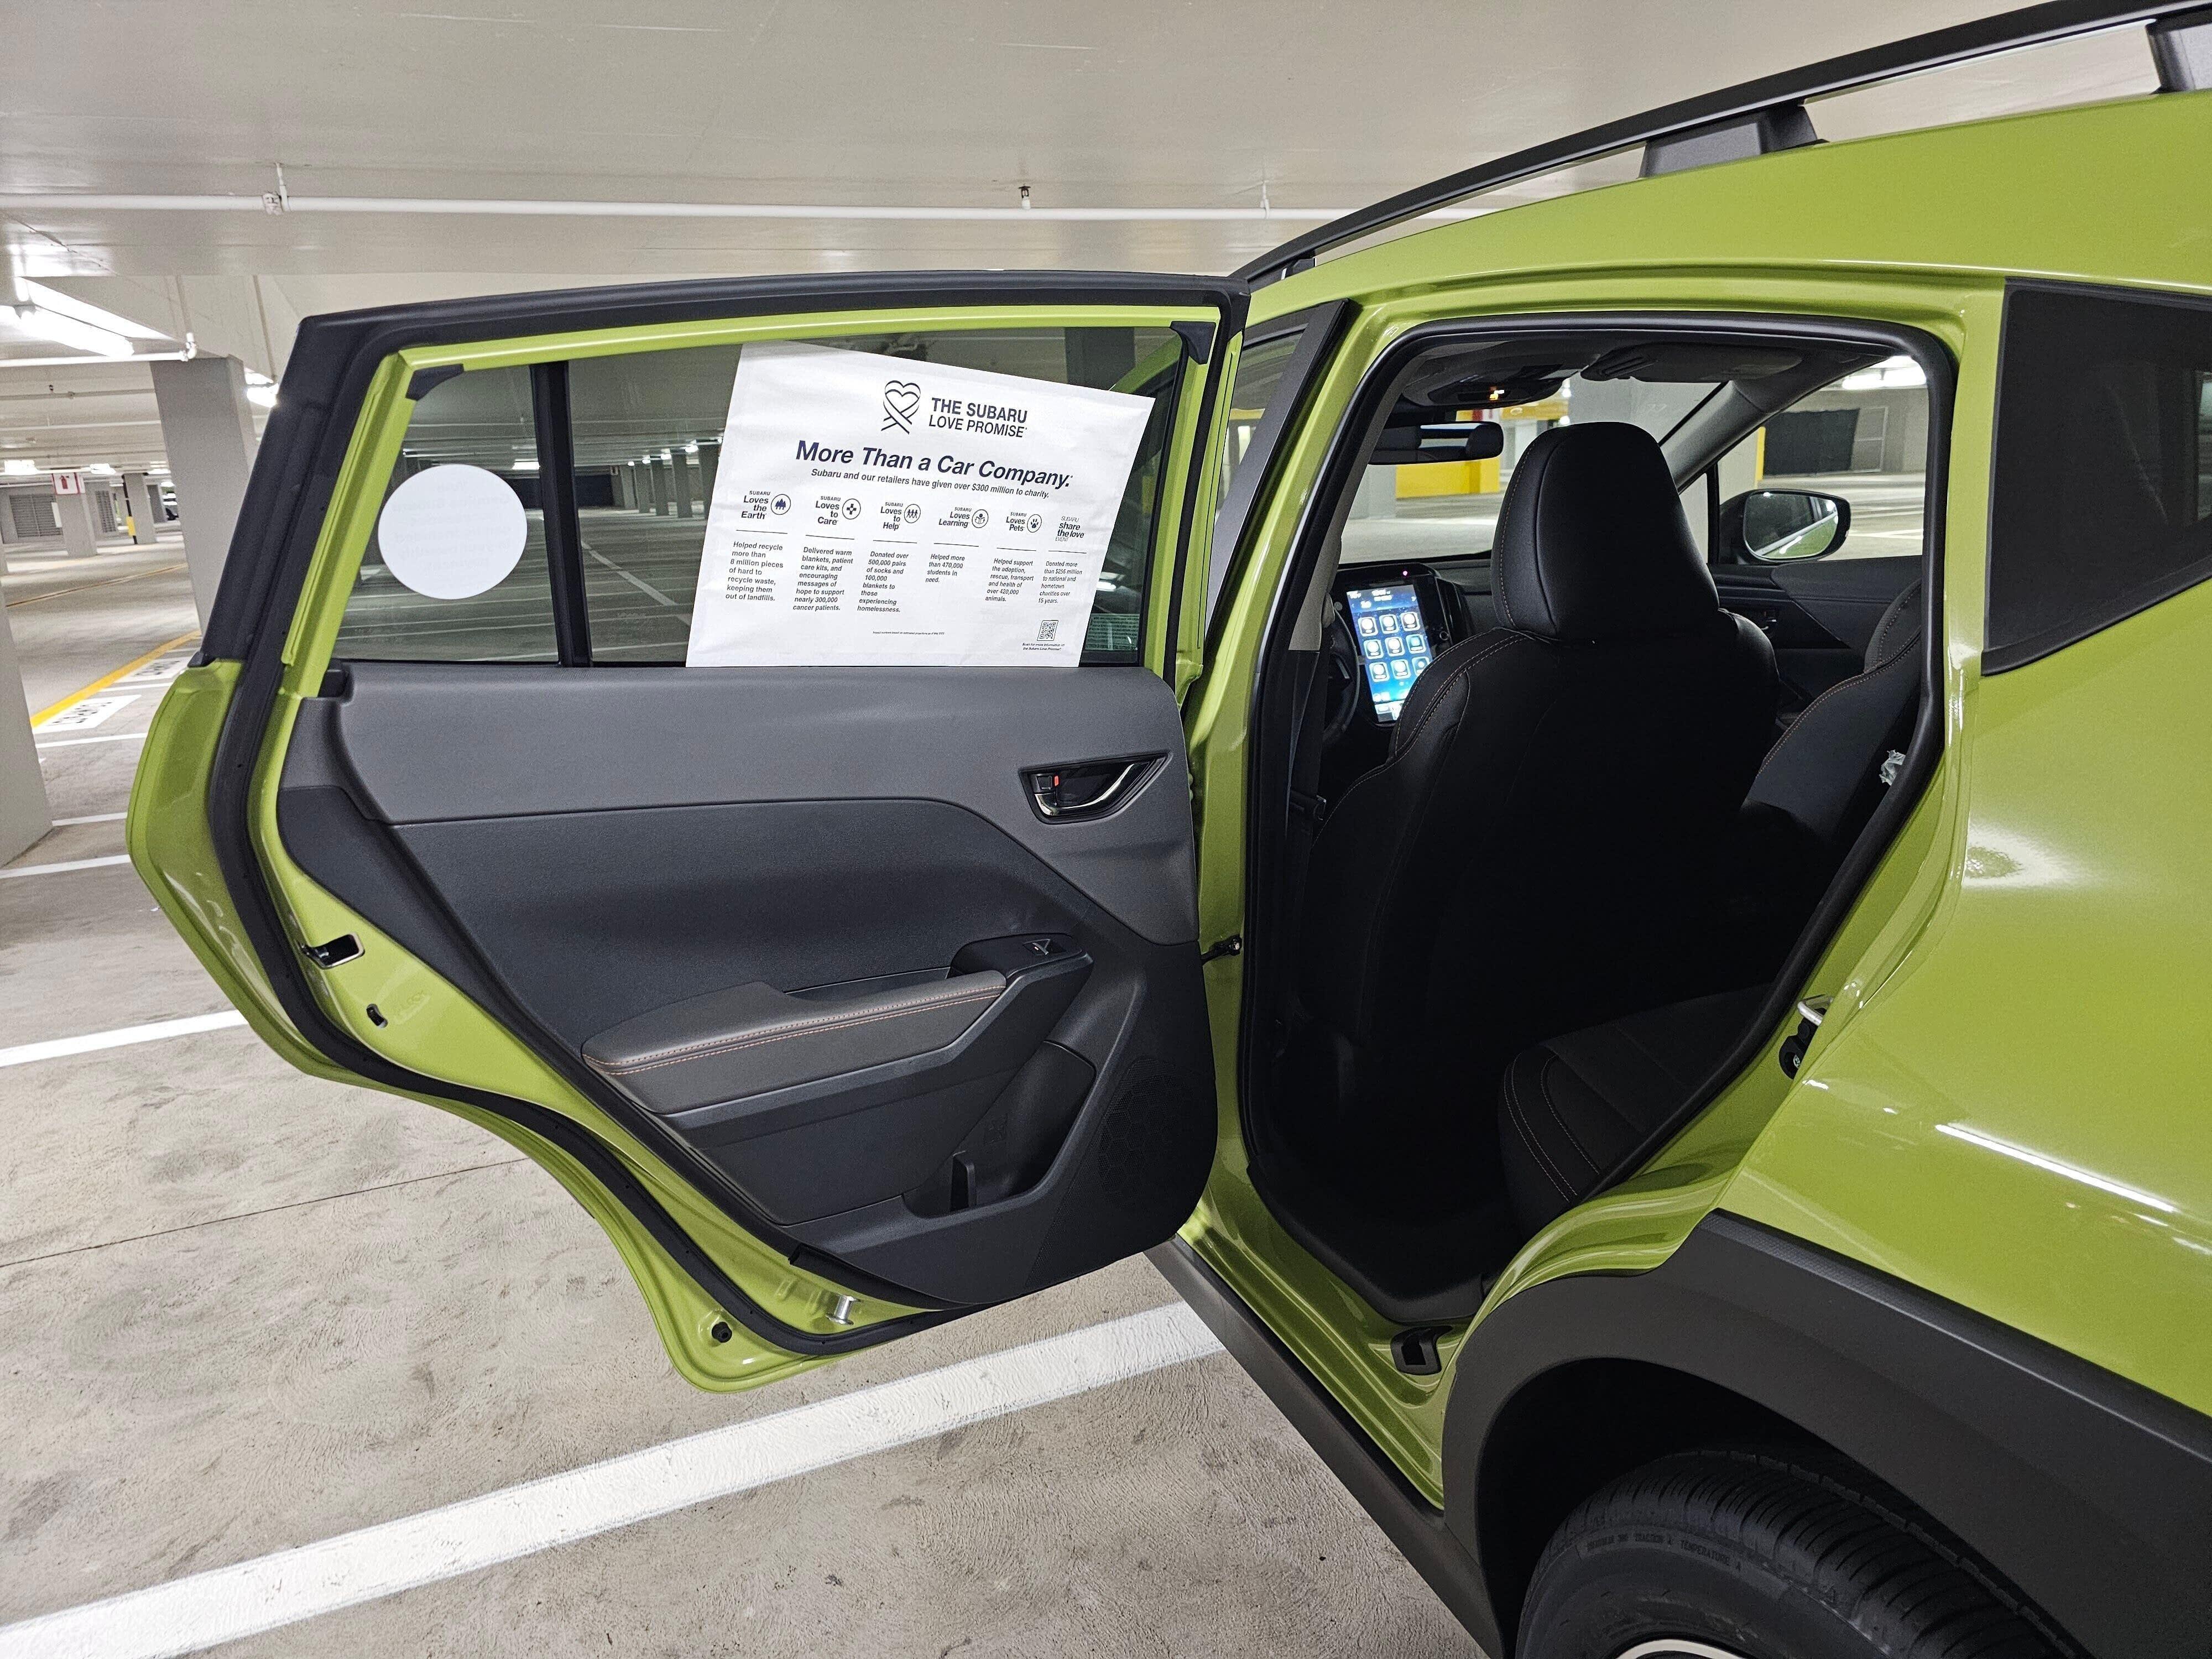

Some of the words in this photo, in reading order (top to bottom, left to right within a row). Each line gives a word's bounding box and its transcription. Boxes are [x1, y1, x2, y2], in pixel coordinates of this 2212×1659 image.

[932, 398, 962, 415] THE
[967, 403, 1027, 423] SUBARU
[928, 415, 963, 430] LOVE
[967, 420, 1024, 437] PROMISE
[796, 440, 854, 463] More
[863, 447, 913, 469] Than
[918, 457, 931, 471] a
[937, 455, 974, 475] Car
[979, 461, 1070, 489] Company.
[811, 468, 841, 478] Subaru
[877, 475, 910, 484] retailers
[911, 478, 930, 486] have
[932, 480, 952, 489] given
[972, 483, 989, 492] $300
[1024, 489, 1049, 499] charity.
[743, 495, 769, 504] Loves
[815, 500, 839, 510] Loves
[741, 511, 765, 519] Earth
[880, 506, 902, 515] Loves
[817, 517, 837, 525] Care
[938, 519, 968, 528] Learning
[1059, 521, 1081, 530] share
[883, 522, 899, 531] Help
[802, 555, 831, 564] blankets,
[727, 585, 754, 593] keeping
